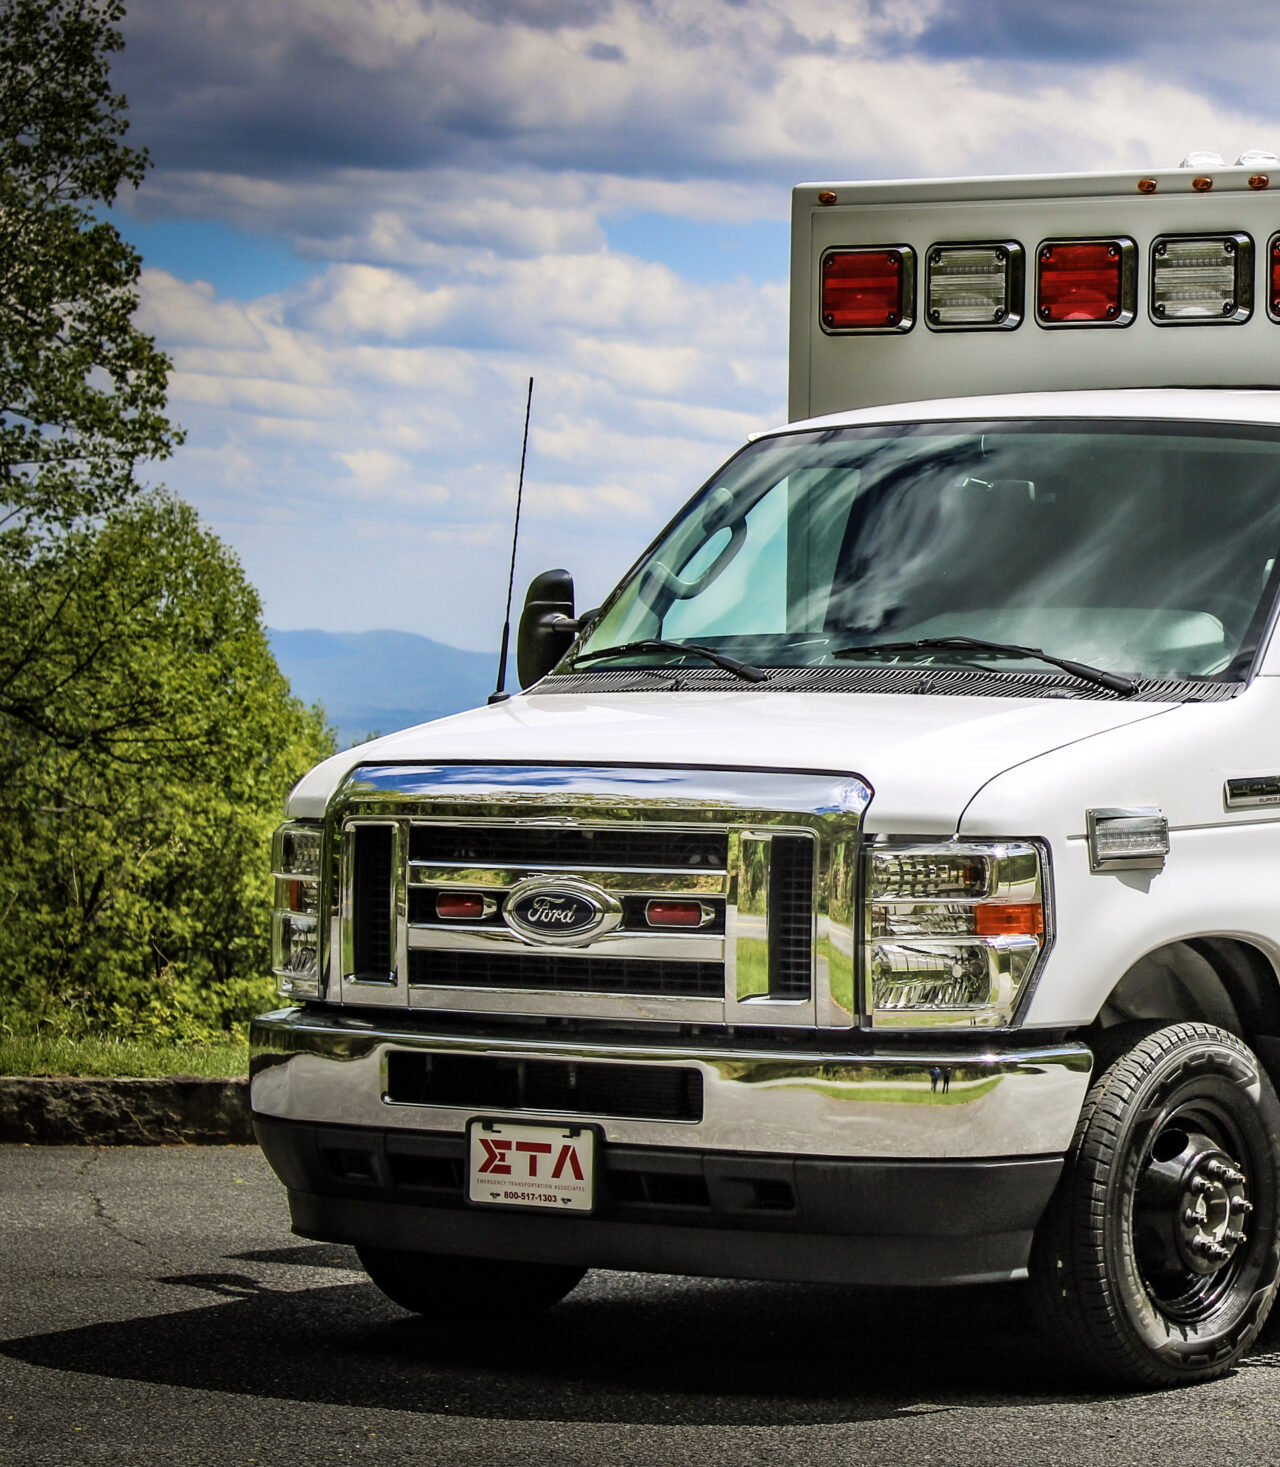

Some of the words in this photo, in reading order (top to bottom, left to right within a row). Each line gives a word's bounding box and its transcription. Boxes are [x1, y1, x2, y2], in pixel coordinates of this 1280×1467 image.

[527, 896, 577, 923] Ford
[477, 1178, 507, 1186] EMERGENCY
[508, 1180, 553, 1189] TRANSPORTATION
[504, 1191, 557, 1203] 800-517-1303
